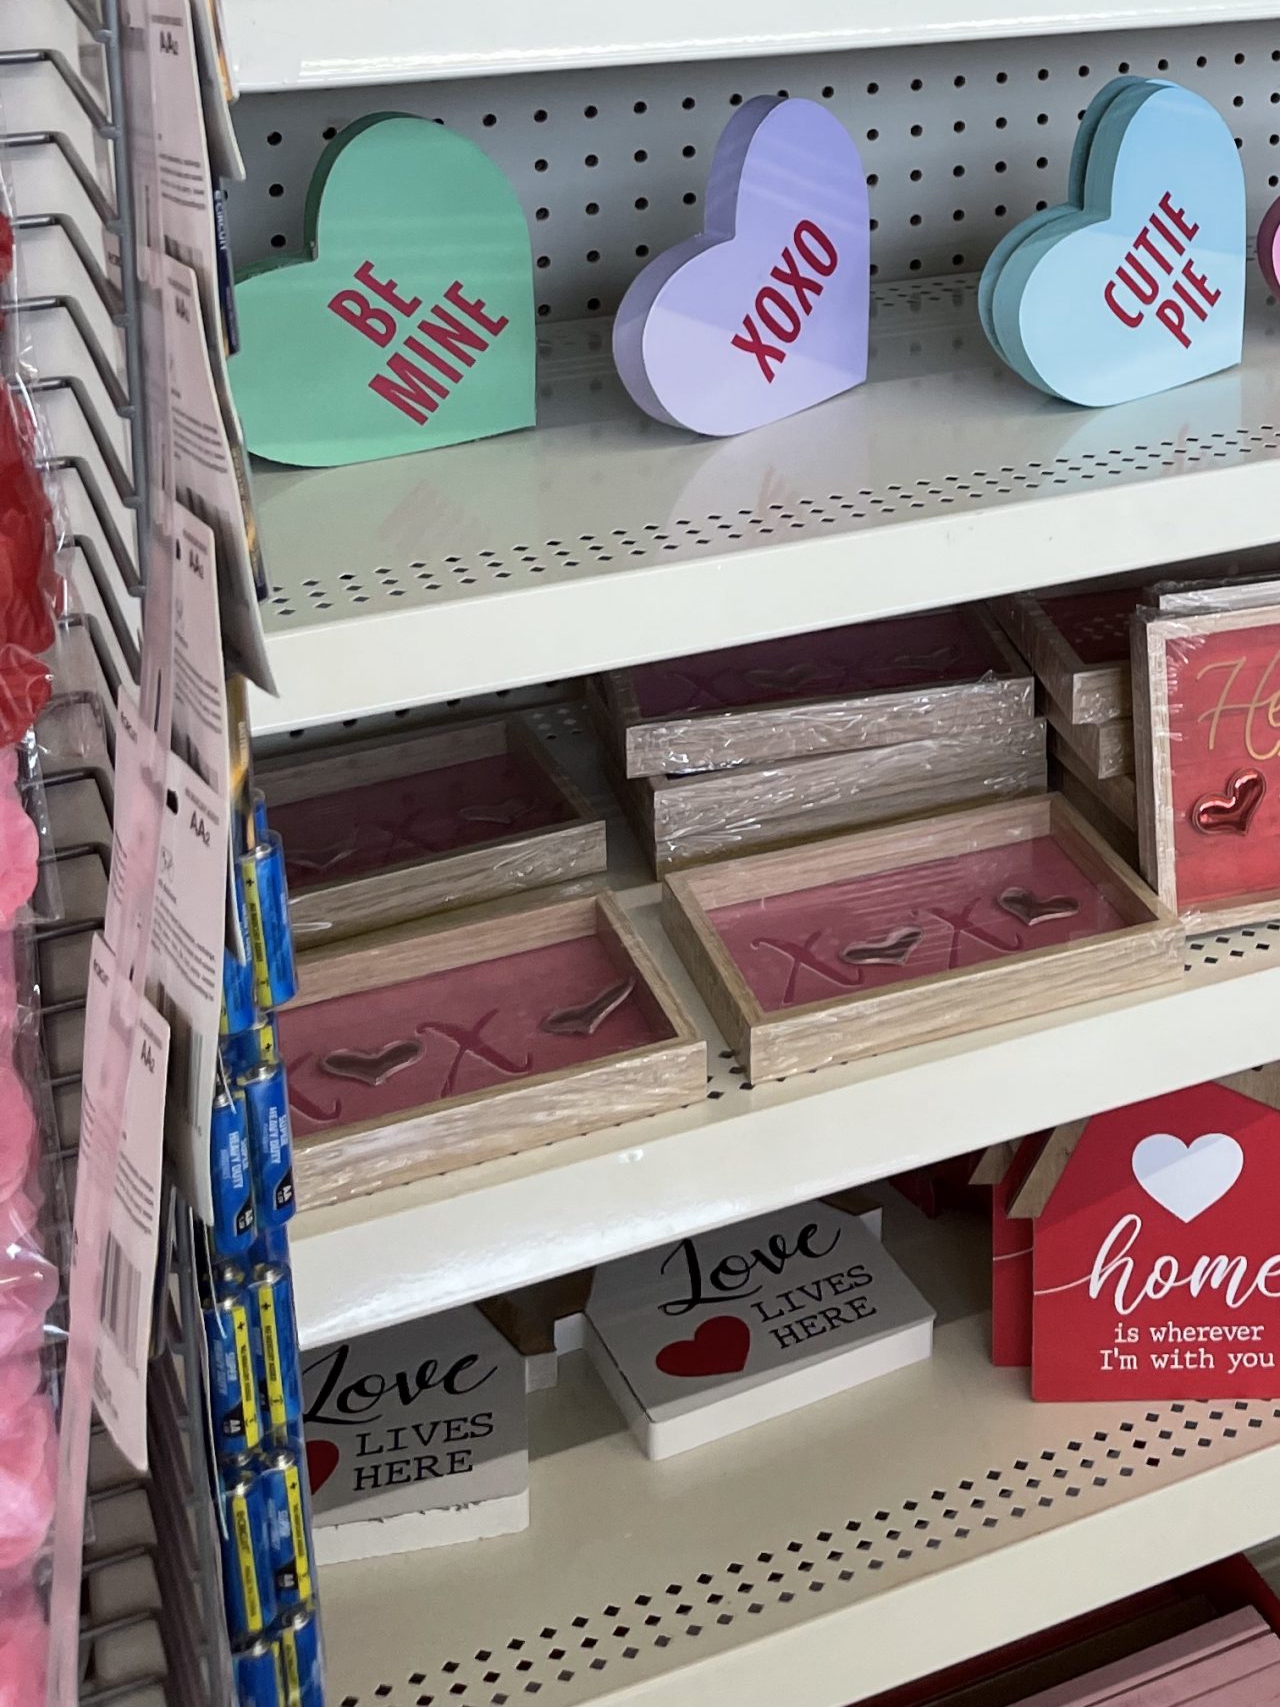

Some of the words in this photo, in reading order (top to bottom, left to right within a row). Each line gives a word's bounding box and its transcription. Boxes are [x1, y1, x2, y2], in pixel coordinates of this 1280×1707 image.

[1103, 191, 1200, 329] CUTIE
[327, 260, 423, 349] BE
[730, 219, 839, 384] XOXO
[1155, 258, 1222, 349] PIE
[367, 280, 510, 427] MINE
[658, 1221, 842, 1316] Love
[751, 1265, 874, 1323] LIVES
[770, 1296, 877, 1351] HERE
[1100, 1349, 1138, 1372] I'm
[1149, 1347, 1215, 1371] with
[1227, 1353, 1275, 1375] you
[1113, 1323, 1140, 1346] is
[1150, 1322, 1265, 1345] wherever
[301, 1345, 498, 1425] Love
[353, 1450, 473, 1492] HERE
[356, 1411, 495, 1457] LIVES
